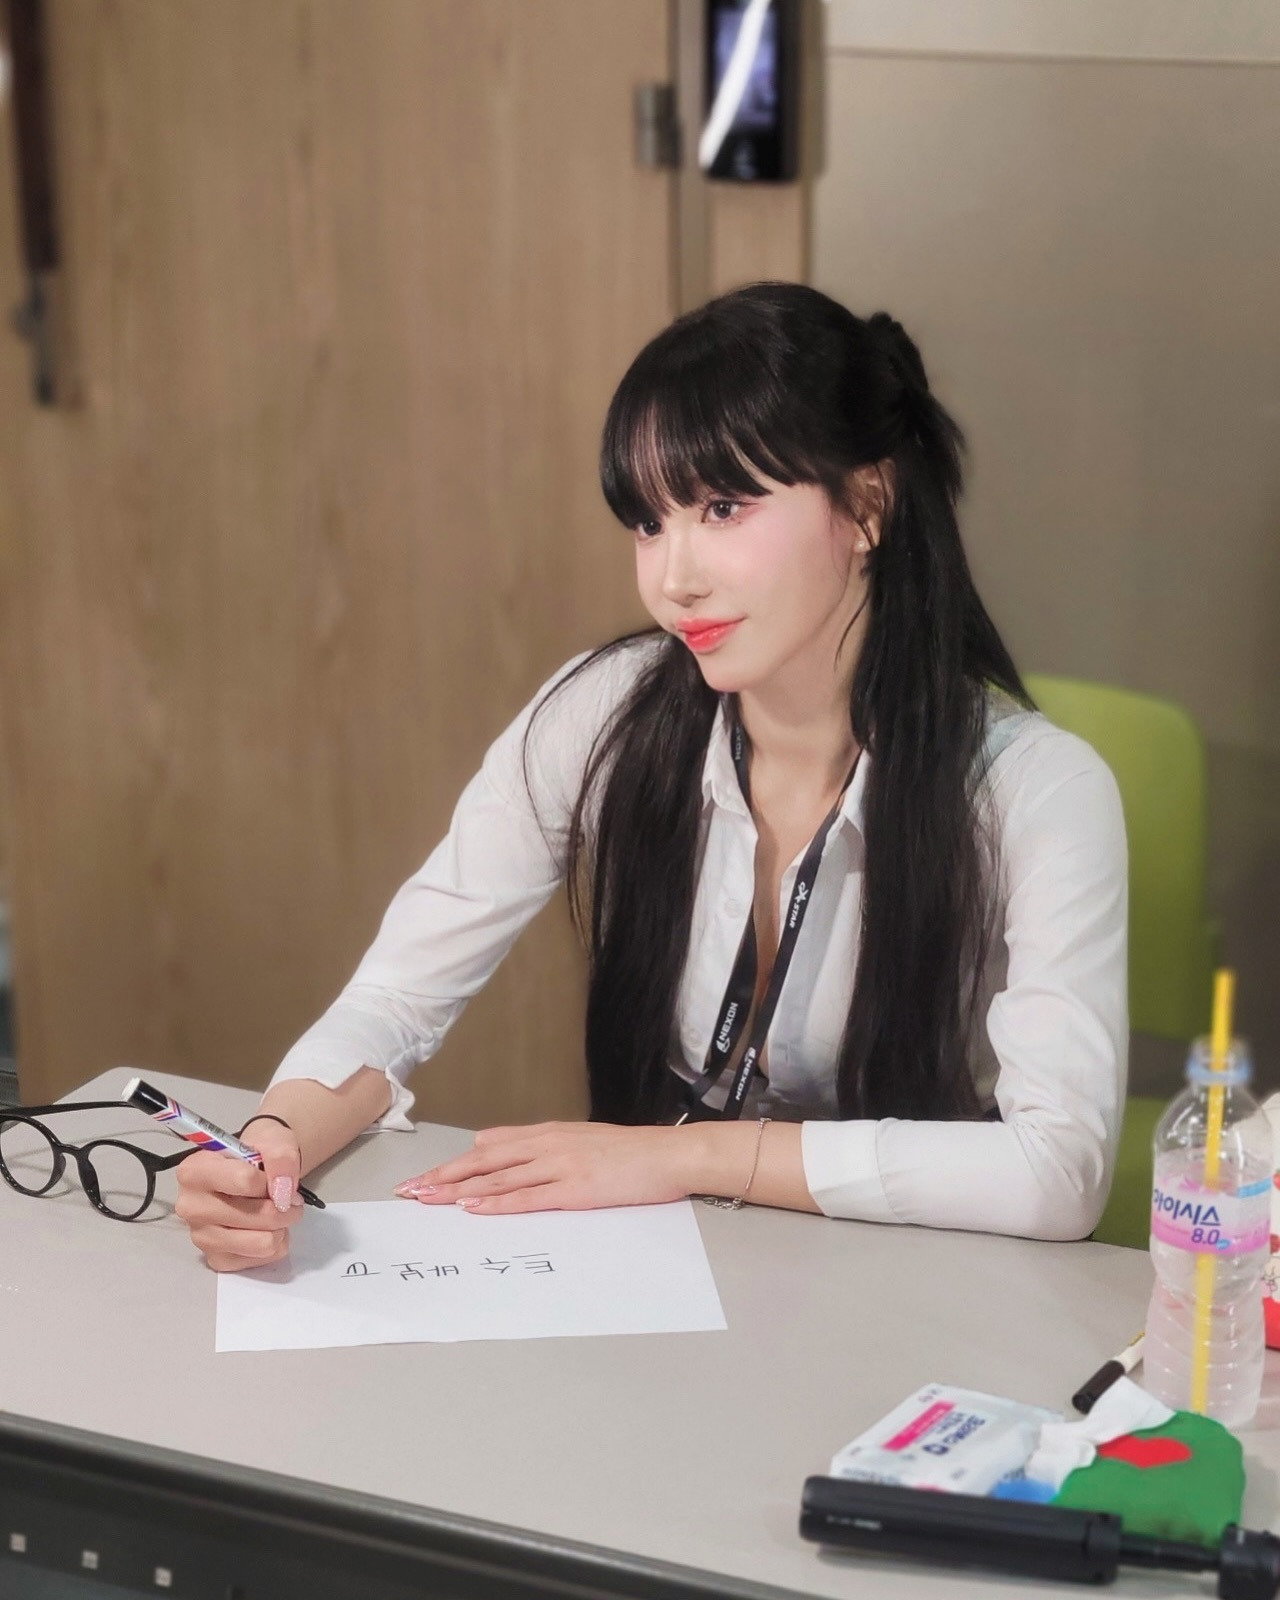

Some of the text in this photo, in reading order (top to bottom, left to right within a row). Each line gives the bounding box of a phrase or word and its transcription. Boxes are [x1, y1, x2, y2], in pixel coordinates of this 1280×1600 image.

[718, 1002, 739, 1042] NEXON
[735, 1059, 753, 1101] NEXON
[1191, 1227, 1220, 1245] 8.0
[390, 1252, 556, 1281] 트수 바보
